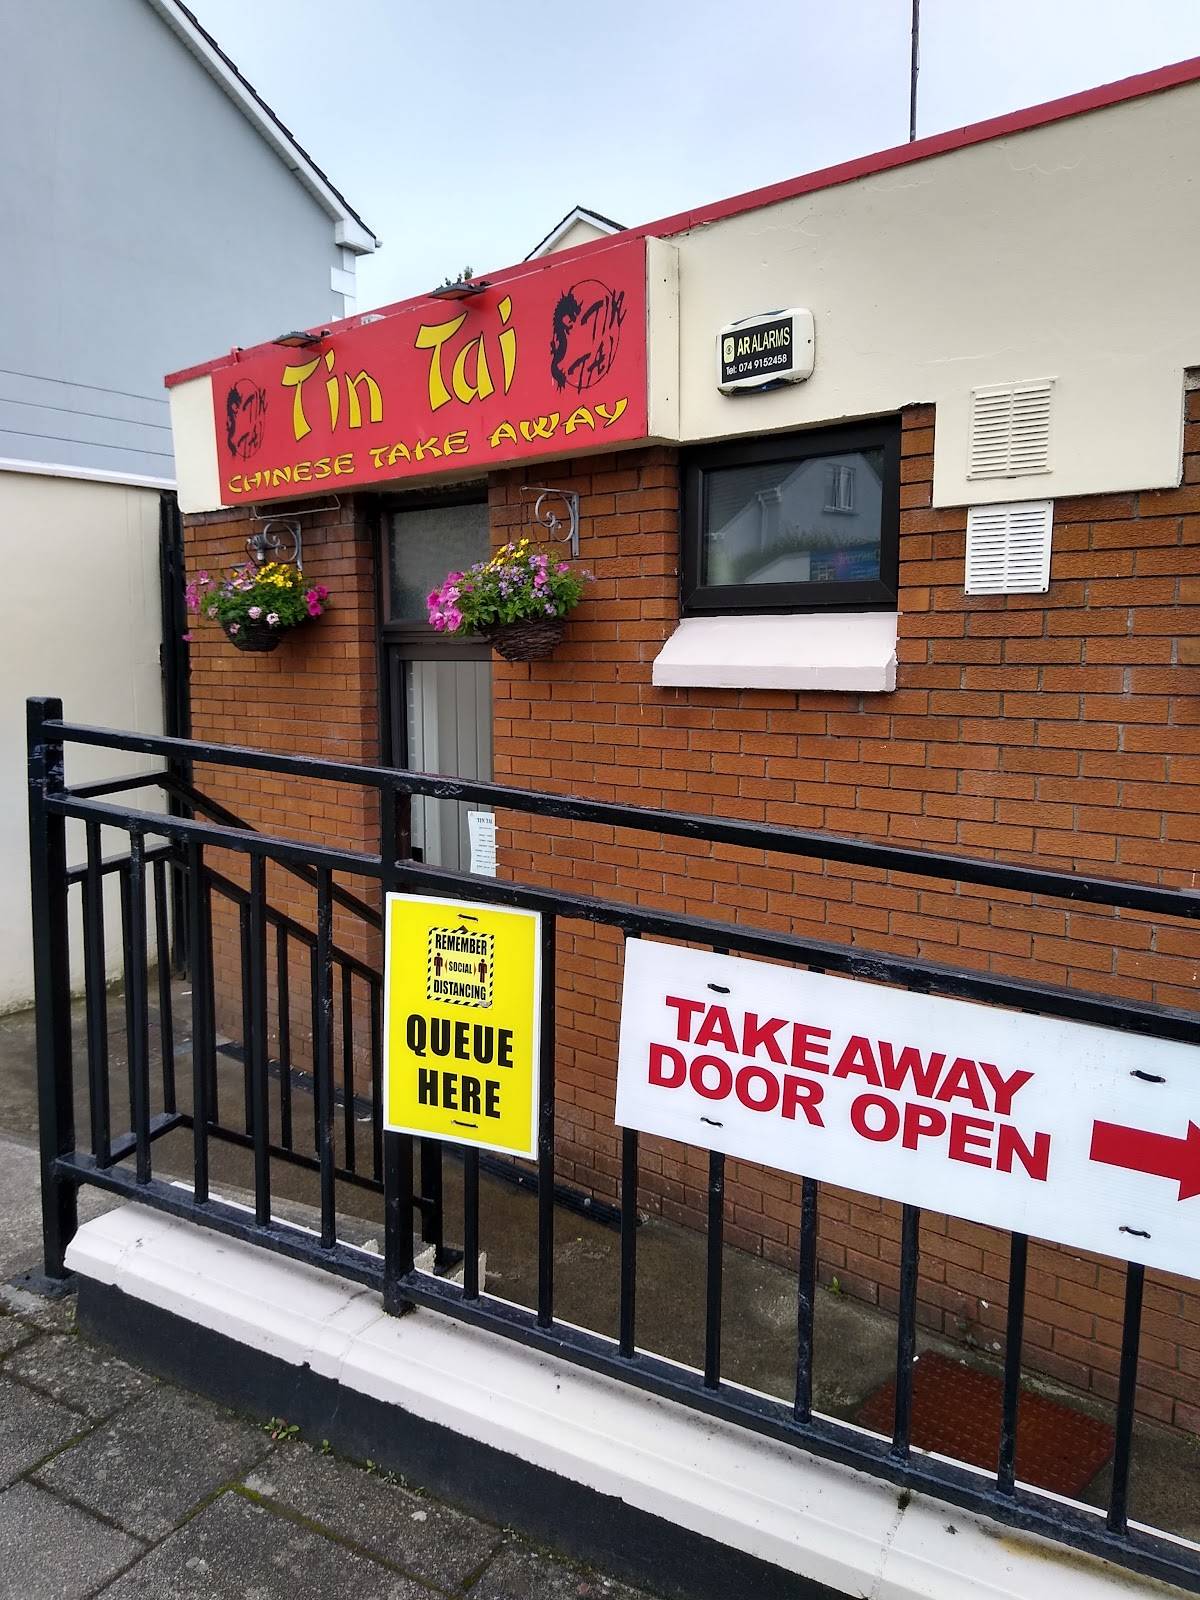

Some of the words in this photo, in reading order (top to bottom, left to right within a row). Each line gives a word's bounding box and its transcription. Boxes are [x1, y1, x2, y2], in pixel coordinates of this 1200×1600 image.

[725, 365, 738, 375] Tel:
[738, 361, 752, 373] 074
[754, 353, 788, 368] 9152458
[737, 336, 751, 356] AR
[751, 326, 791, 353] ALARMS
[281, 348, 383, 442] Tin
[414, 296, 516, 412] Tai
[228, 452, 354, 494] CHINESE
[369, 430, 470, 470] TAKE
[488, 397, 629, 450] AWAY
[435, 933, 488, 956] REMEMBER
[448, 961, 473, 975] SOCIAL
[433, 979, 487, 1001] DISTANCING
[406, 1013, 514, 1069] QUEUE
[665, 995, 1035, 1117] TAKEAWAY
[418, 1067, 502, 1120] HERE
[648, 1042, 826, 1128] DOOR
[849, 1093, 1051, 1182] OPEN
